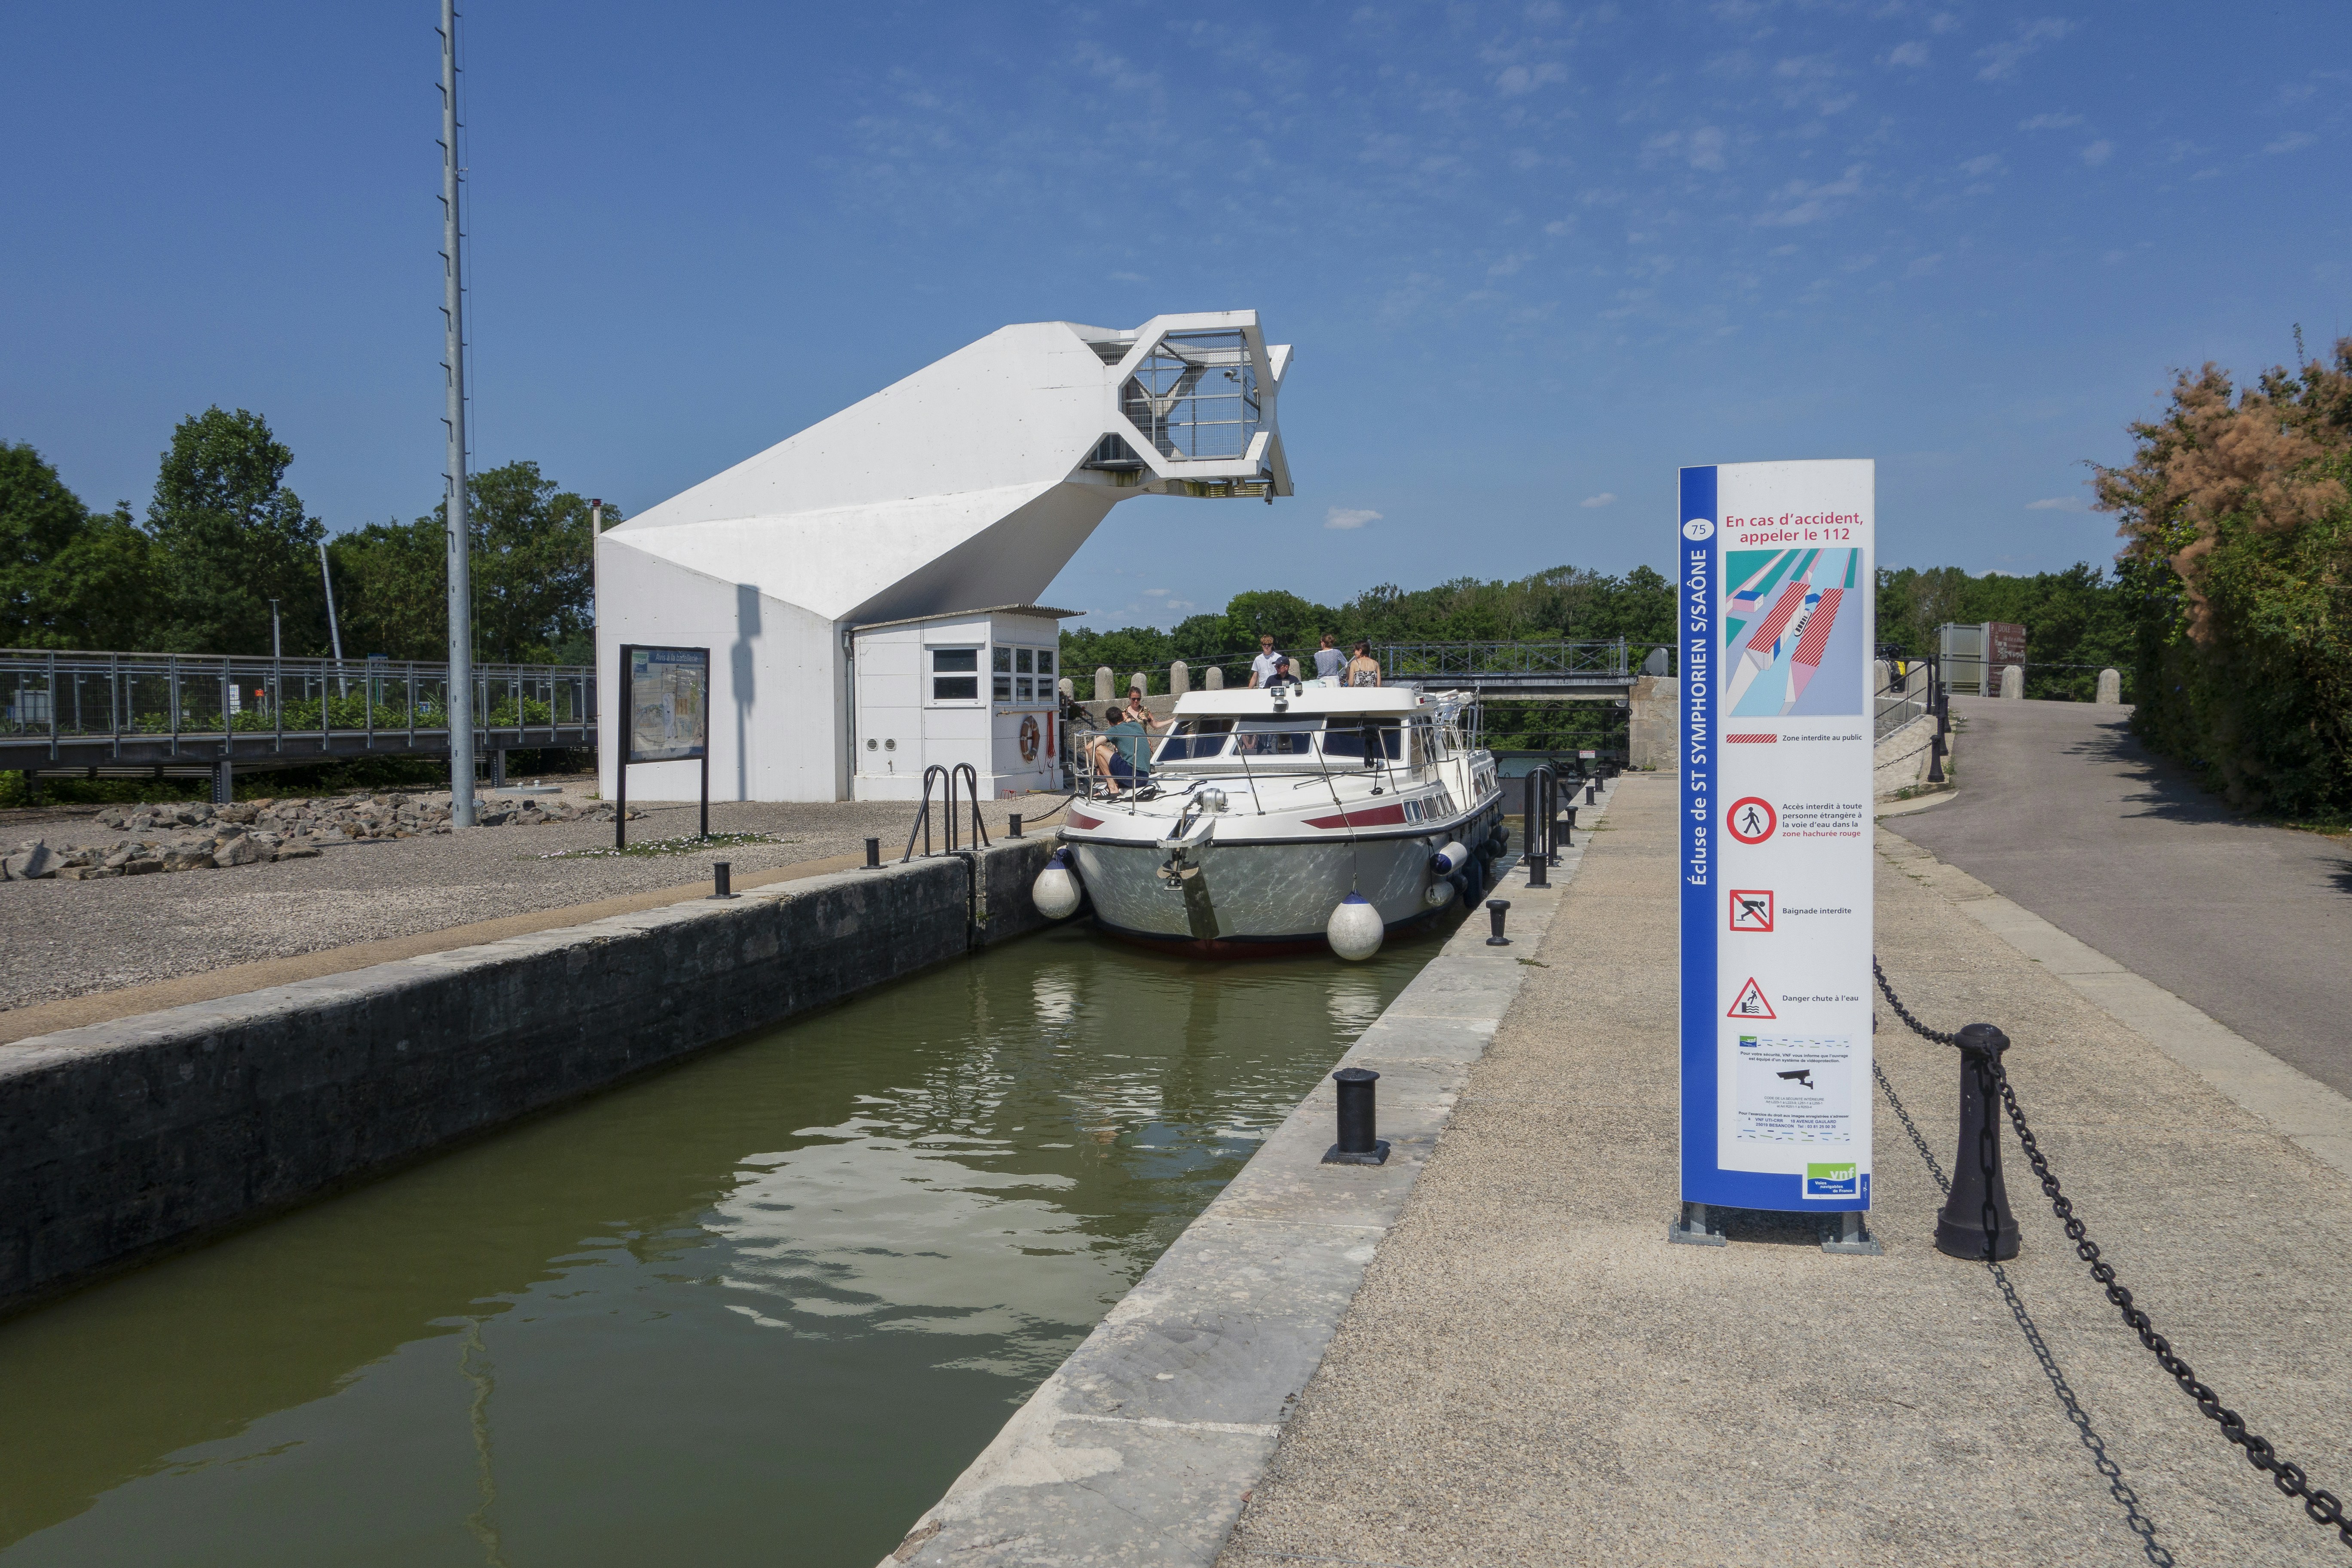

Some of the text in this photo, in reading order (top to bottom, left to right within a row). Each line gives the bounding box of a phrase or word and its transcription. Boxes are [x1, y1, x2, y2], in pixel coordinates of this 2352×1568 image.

[1726, 511, 1863, 527] En cas d'accident,
[1692, 524, 1706, 536] 75
[1740, 528, 1850, 545] appeler le 112
[677, 654, 698, 662] batellerie
[1687, 550, 1707, 885] Écluse de ST SYMPHORIEN S/SAÔNE
[1830, 1167, 1854, 1180] vnf
